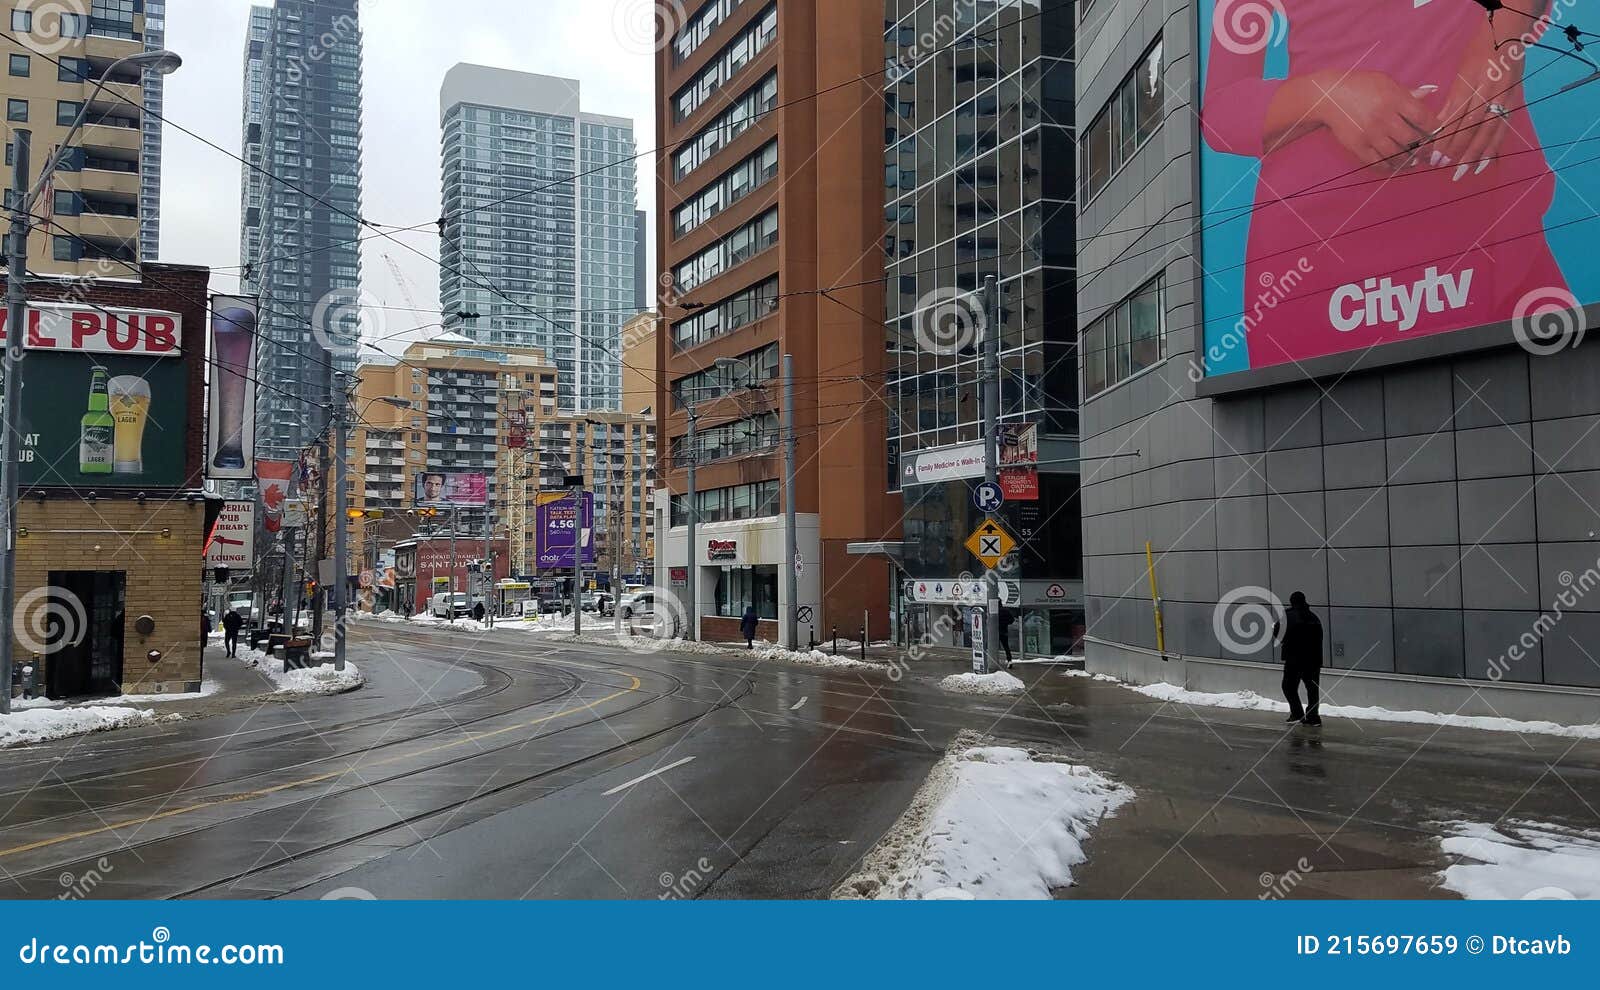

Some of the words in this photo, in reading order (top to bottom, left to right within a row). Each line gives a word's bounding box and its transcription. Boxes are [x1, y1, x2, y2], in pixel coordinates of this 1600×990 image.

[1328, 266, 1474, 332] Citytv
[72, 312, 176, 352] PUB
[24, 433, 40, 446] AT
[18, 450, 35, 462] UB
[918, 463, 933, 473] Family
[934, 461, 955, 470] Medicine
[980, 487, 996, 507] P
[549, 520, 577, 528] 4.5G
[1021, 528, 1032, 536] 55
[420, 561, 467, 569] SANTOU
